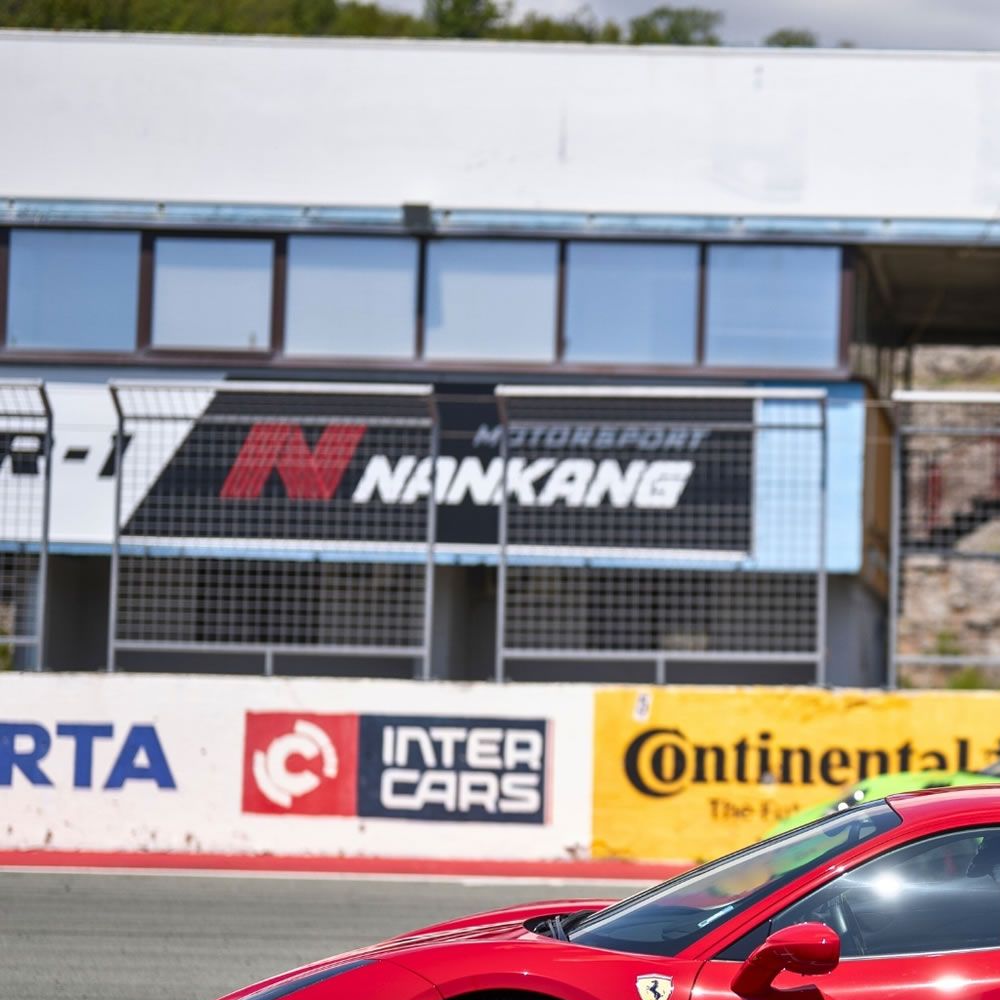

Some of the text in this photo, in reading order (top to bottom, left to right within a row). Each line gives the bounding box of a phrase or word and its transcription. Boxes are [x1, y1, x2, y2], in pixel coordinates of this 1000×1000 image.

[472, 423, 710, 449] MOTORSPORT
[352, 455, 693, 508] NANKANG
[382, 726, 545, 770] INTER
[624, 727, 969, 798] Continental
[380, 769, 541, 814] CARS
